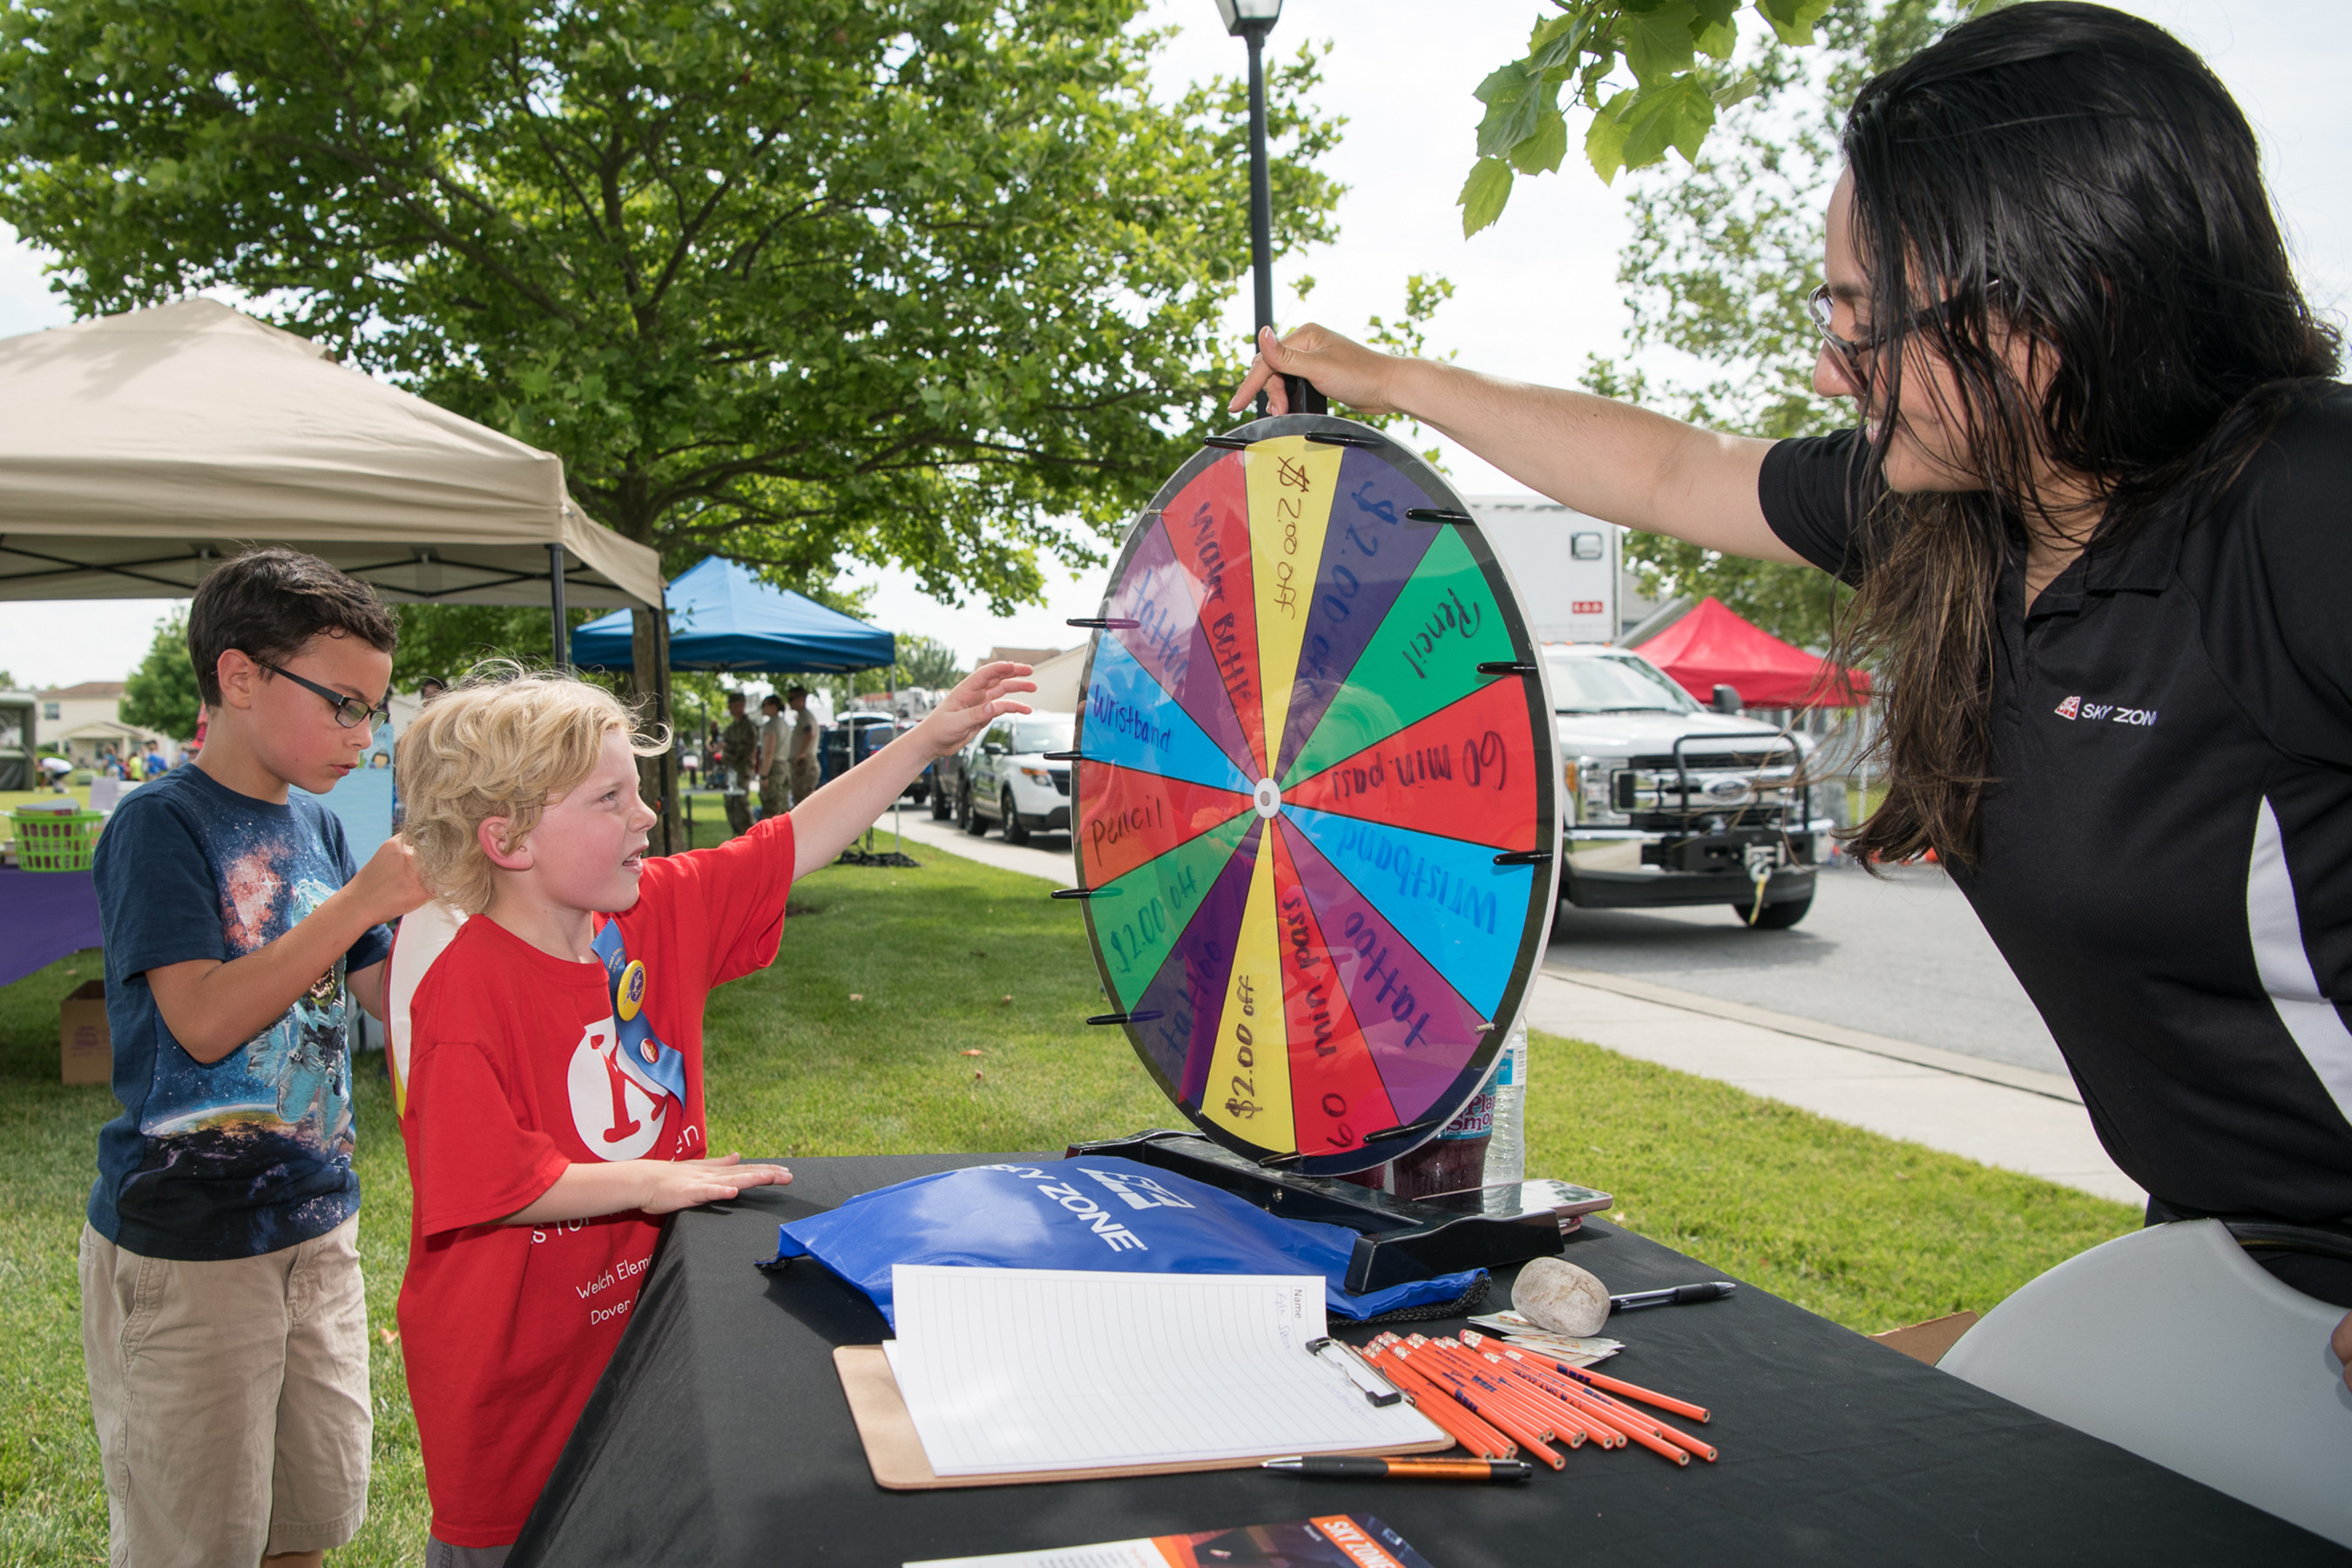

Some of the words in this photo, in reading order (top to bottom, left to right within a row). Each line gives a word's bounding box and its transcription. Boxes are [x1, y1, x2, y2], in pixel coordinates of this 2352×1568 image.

[1274, 561, 1296, 620] off
[2081, 703, 2113, 720] SKY
[1332, 752, 1384, 801] pass
[1463, 730, 1506, 791] 60
[1110, 897, 1166, 974] $2.00
[1169, 865, 1197, 910] off
[1282, 896, 1321, 970] pass
[1239, 974, 1257, 1017] off
[1344, 911, 1430, 1049] tattoo
[1225, 1023, 1263, 1120] $2.00
[1321, 1092, 1354, 1148] 60
[1037, 1182, 1146, 1253] ZONE
[575, 1268, 615, 1300] Welch
[1293, 1288, 1303, 1320] Name
[591, 1300, 631, 1326] Dover
[1322, 1520, 1366, 1543] SKY
